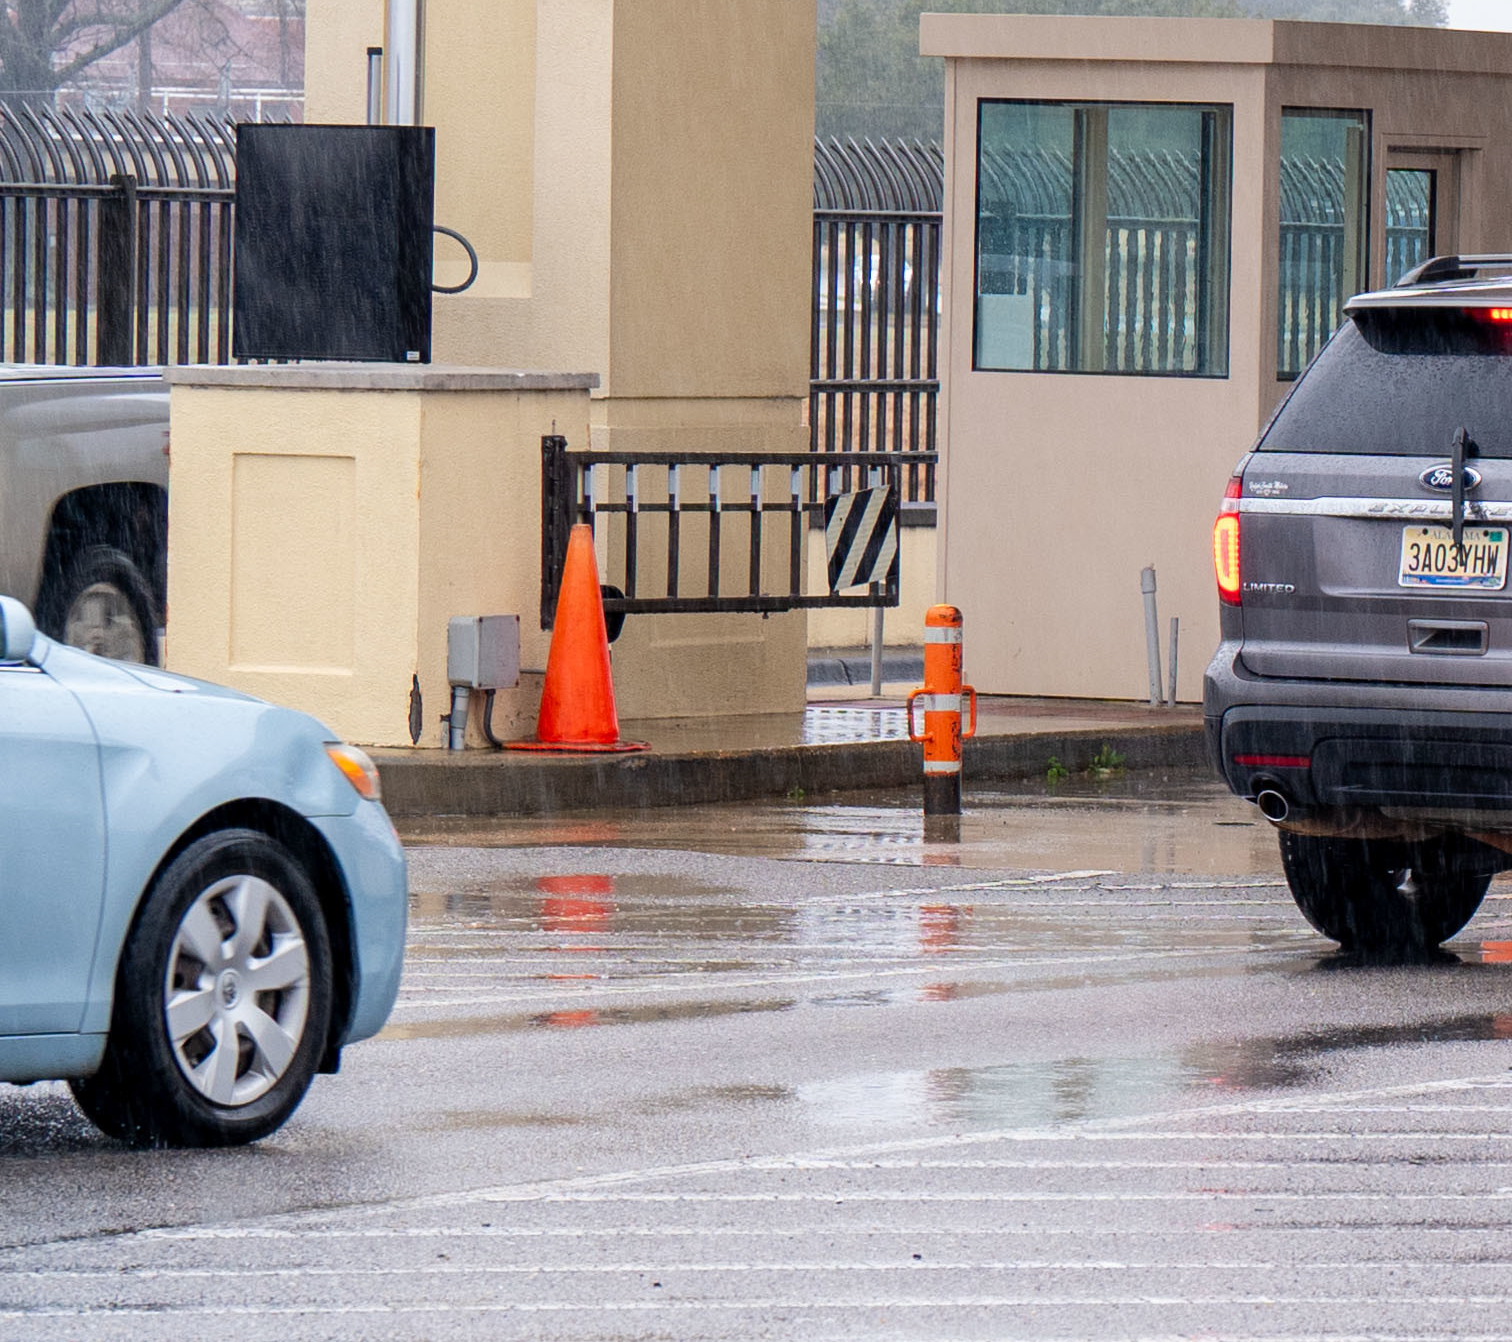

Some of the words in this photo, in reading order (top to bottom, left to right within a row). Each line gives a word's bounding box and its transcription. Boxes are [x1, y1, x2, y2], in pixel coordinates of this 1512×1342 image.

[1431, 530, 1481, 540] ALAMA
[1409, 543, 1499, 574] 3A03YHW
[1243, 581, 1296, 594] LIMITED
